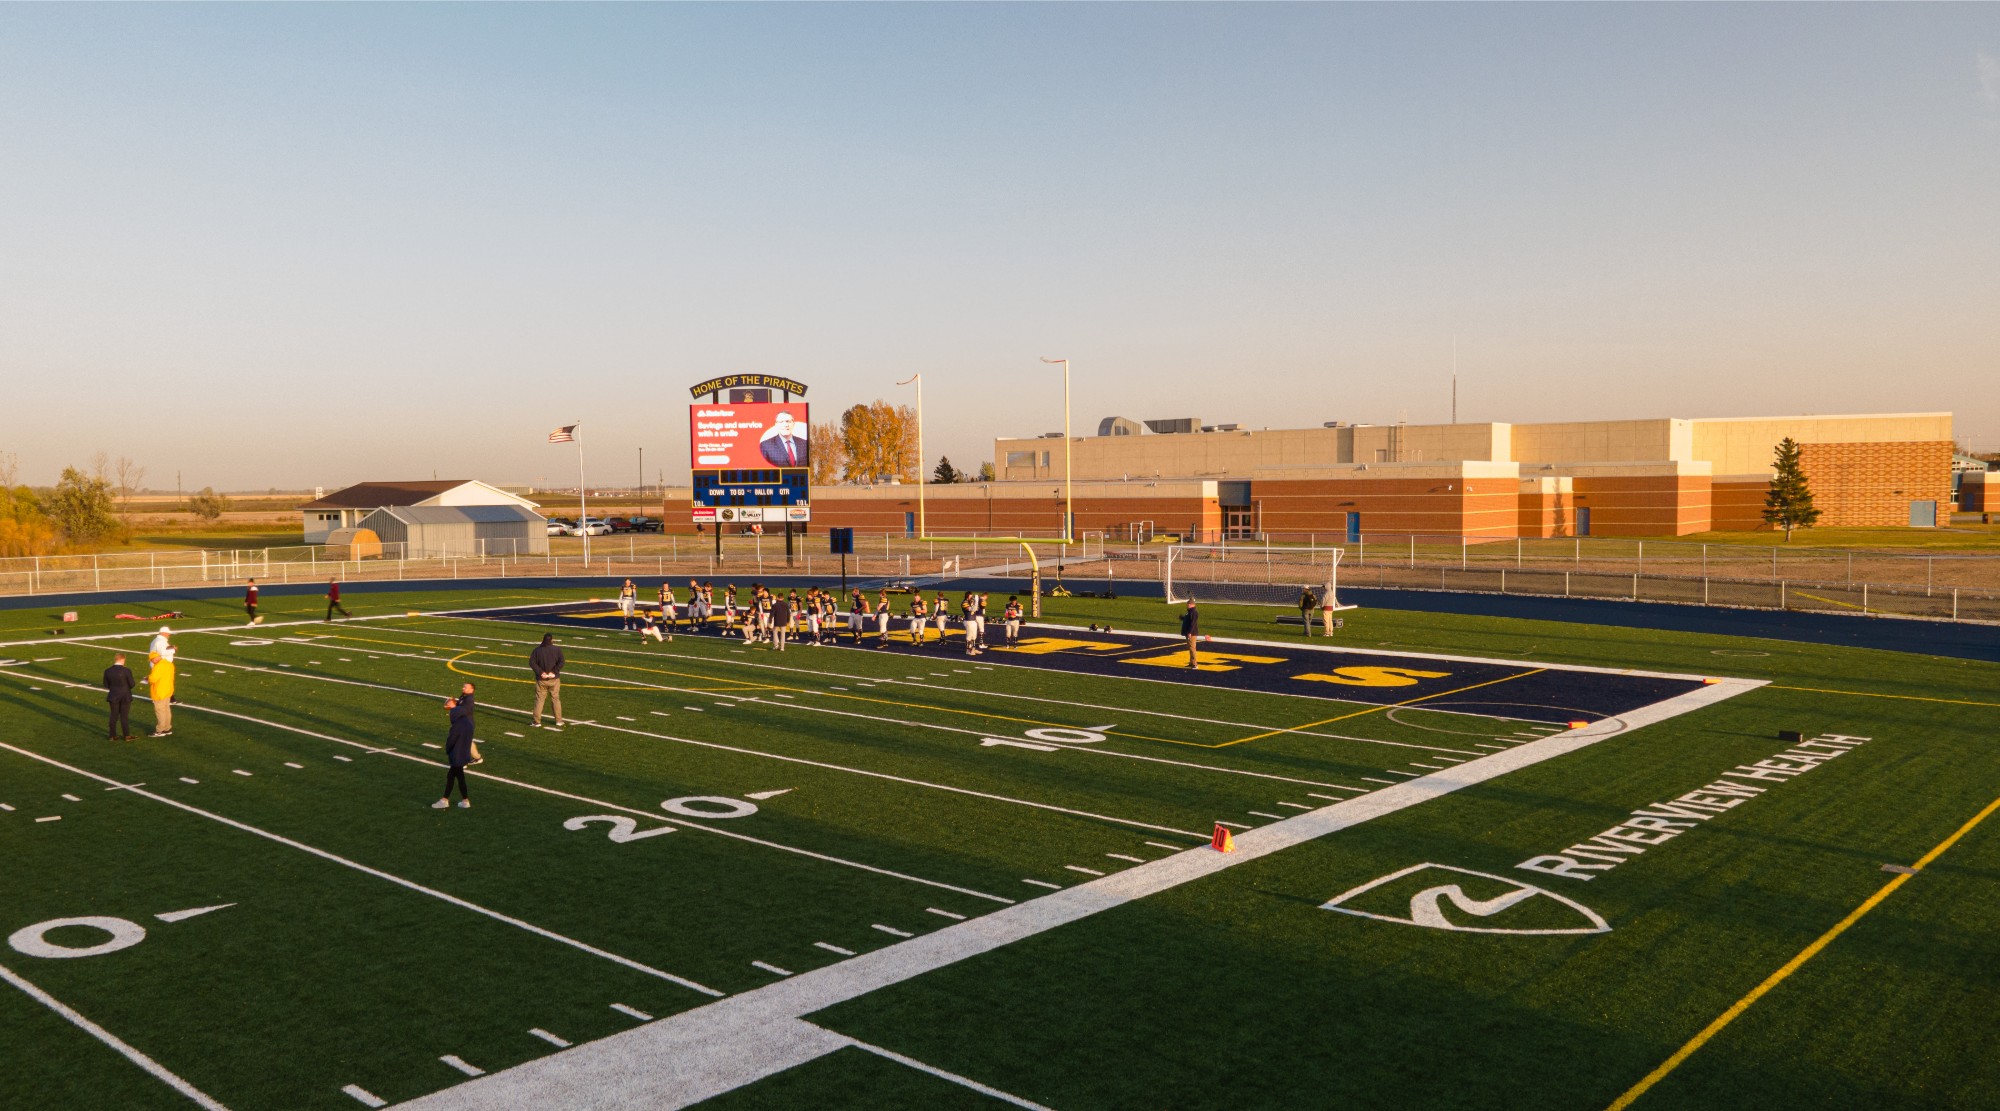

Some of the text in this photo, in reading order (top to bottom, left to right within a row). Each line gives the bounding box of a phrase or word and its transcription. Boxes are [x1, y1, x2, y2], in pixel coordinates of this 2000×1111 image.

[693, 375, 804, 396] HOME OF THE PIRATES
[697, 421, 723, 430] Savings
[738, 421, 763, 429] service
[979, 727, 1108, 752] 10
[1721, 733, 1873, 782] HEALTH
[563, 795, 759, 844] 20
[1514, 779, 1768, 881] RIVERVIEW
[1213, 826, 1225, 848] 10
